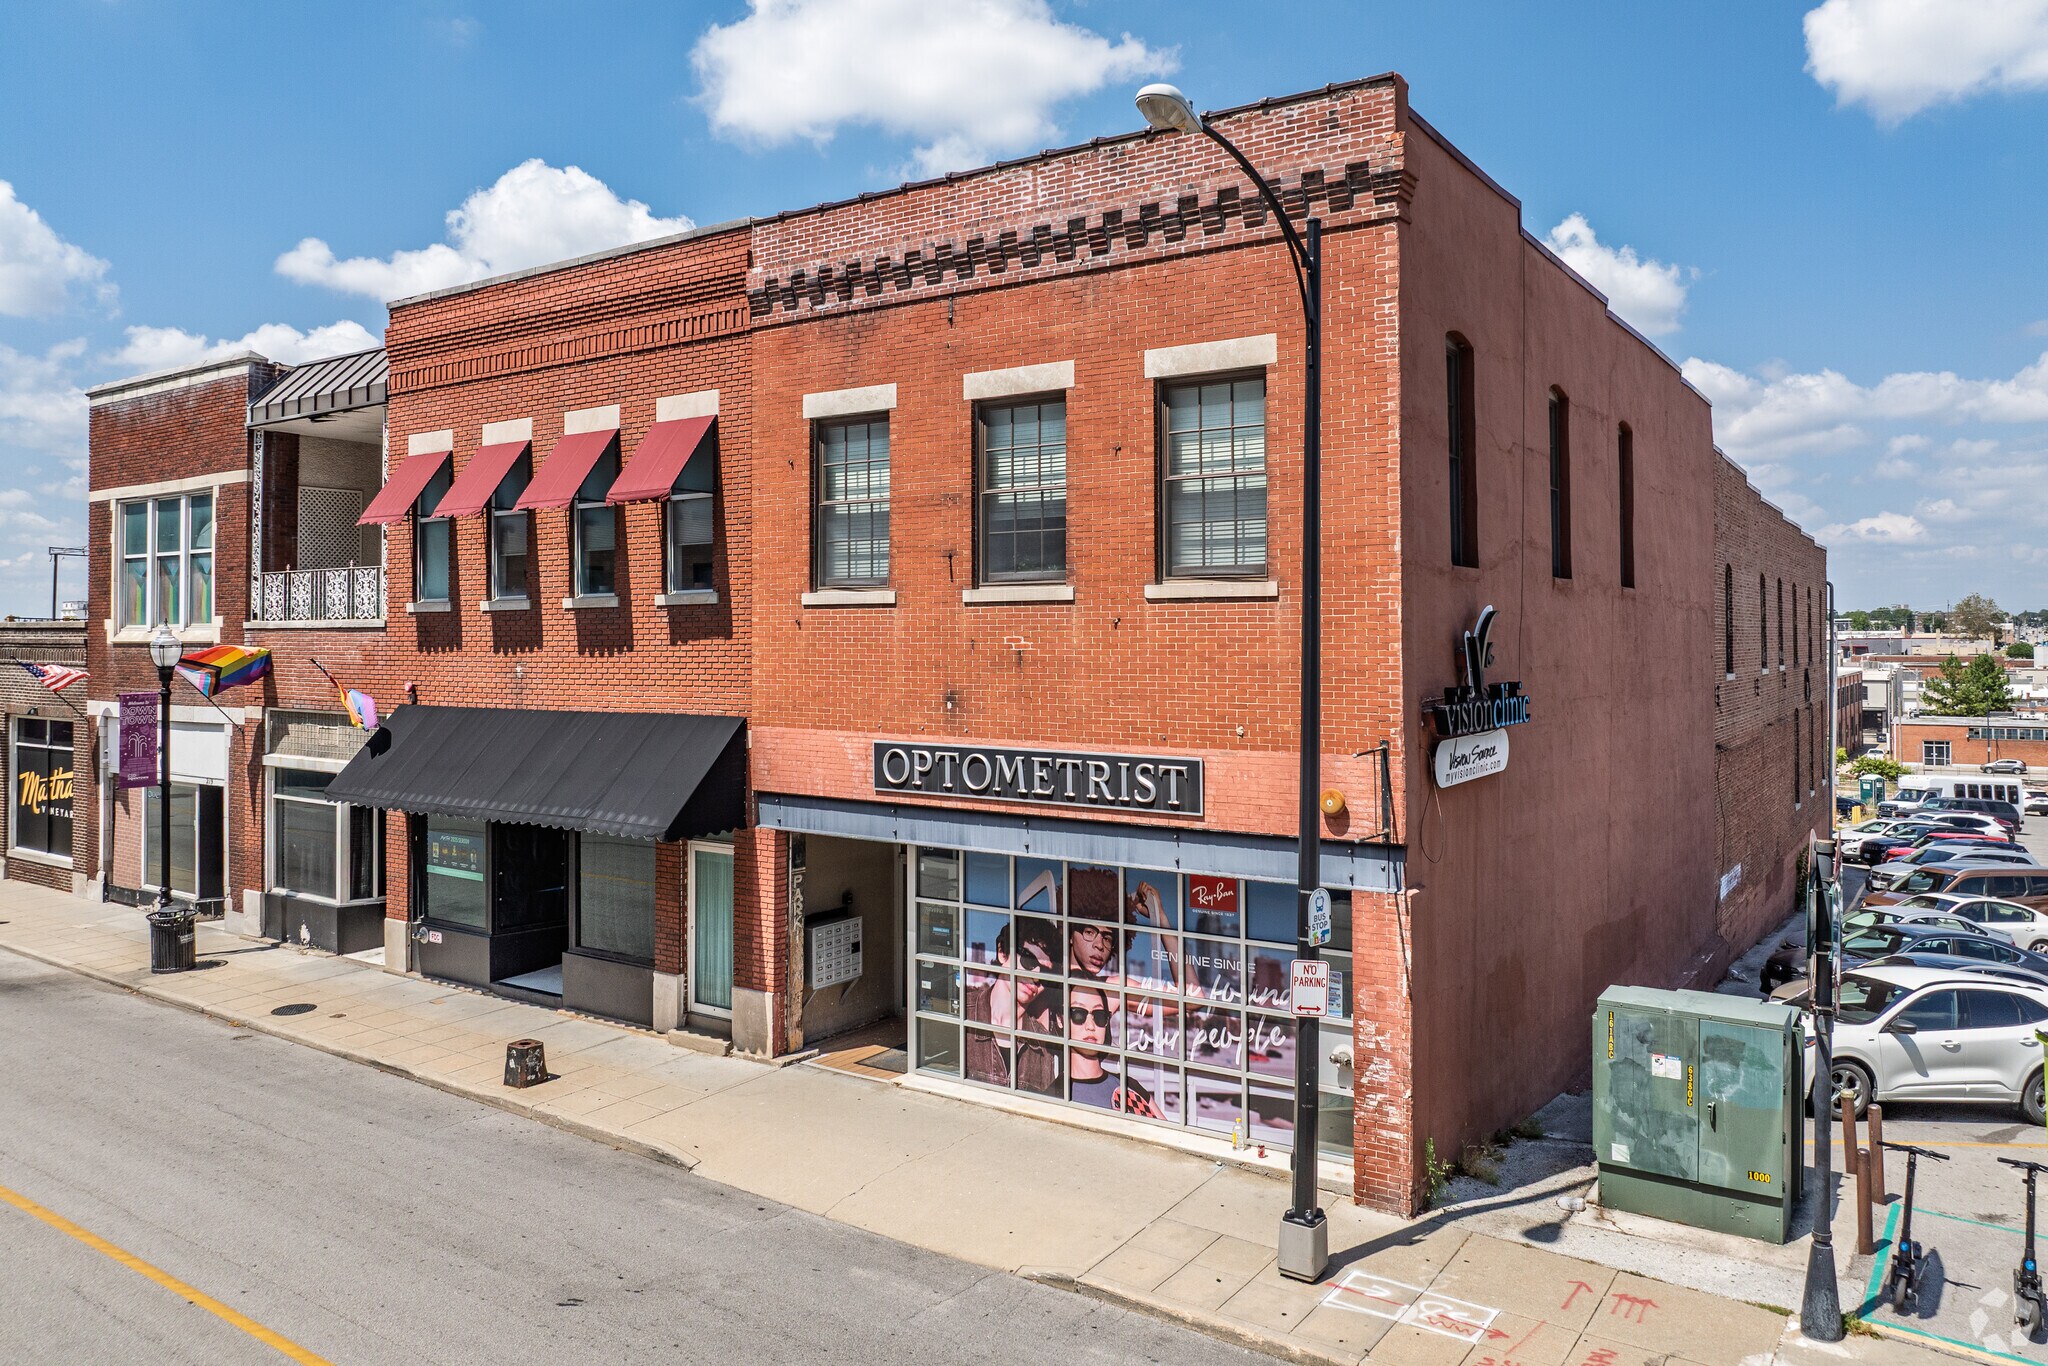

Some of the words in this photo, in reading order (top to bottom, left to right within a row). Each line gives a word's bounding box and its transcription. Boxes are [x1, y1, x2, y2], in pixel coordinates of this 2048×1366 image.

[121, 705, 157, 716] DOWN
[121, 714, 157, 725] TOWN
[882, 748, 1189, 806] OPTOMETRIST
[1313, 912, 1326, 923] BUS
[1312, 920, 1328, 931] STOP
[1303, 964, 1317, 975] NO
[1293, 977, 1326, 988] PARKING
[1748, 1171, 1770, 1184] 1000
